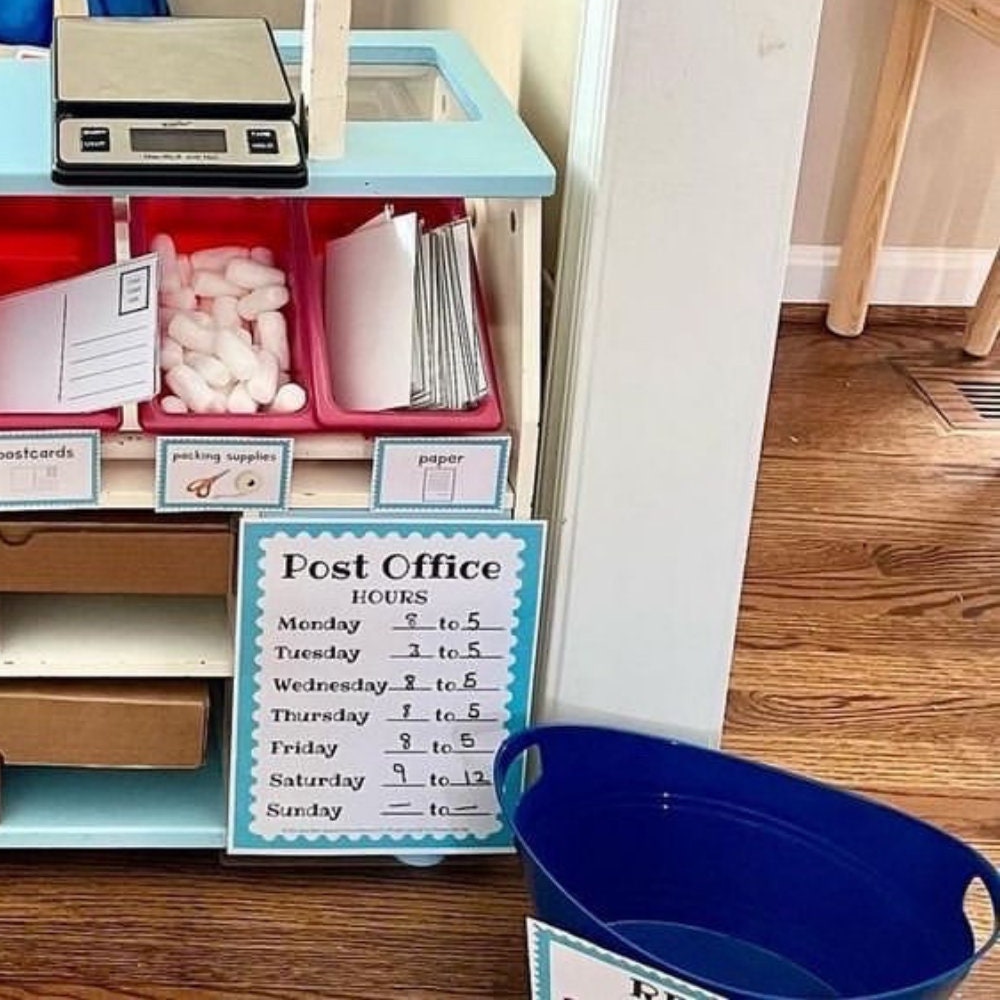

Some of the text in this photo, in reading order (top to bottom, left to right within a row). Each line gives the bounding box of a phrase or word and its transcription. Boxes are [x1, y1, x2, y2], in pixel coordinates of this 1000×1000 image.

[172, 449, 277, 465] packing supplies
[418, 454, 465, 470] paper
[282, 552, 501, 580] Post Office
[351, 589, 428, 605] HOURS
[277, 616, 361, 635] Monday
[440, 617, 459, 631] to
[468, 612, 480, 630] 5
[274, 645, 361, 664] Tuesday
[439, 646, 459, 659] to
[468, 641, 480, 658] 5
[273, 678, 388, 696] Wednesday
[436, 678, 456, 691] to
[270, 708, 370, 727] Thursday
[436, 709, 455, 721] to
[468, 703, 480, 718] 5
[271, 733, 475, 759] Friday 8 to 5
[269, 773, 366, 792] Saturday
[393, 763, 406, 783] 9
[430, 774, 450, 786] to
[266, 803, 449, 822] Sunday to
